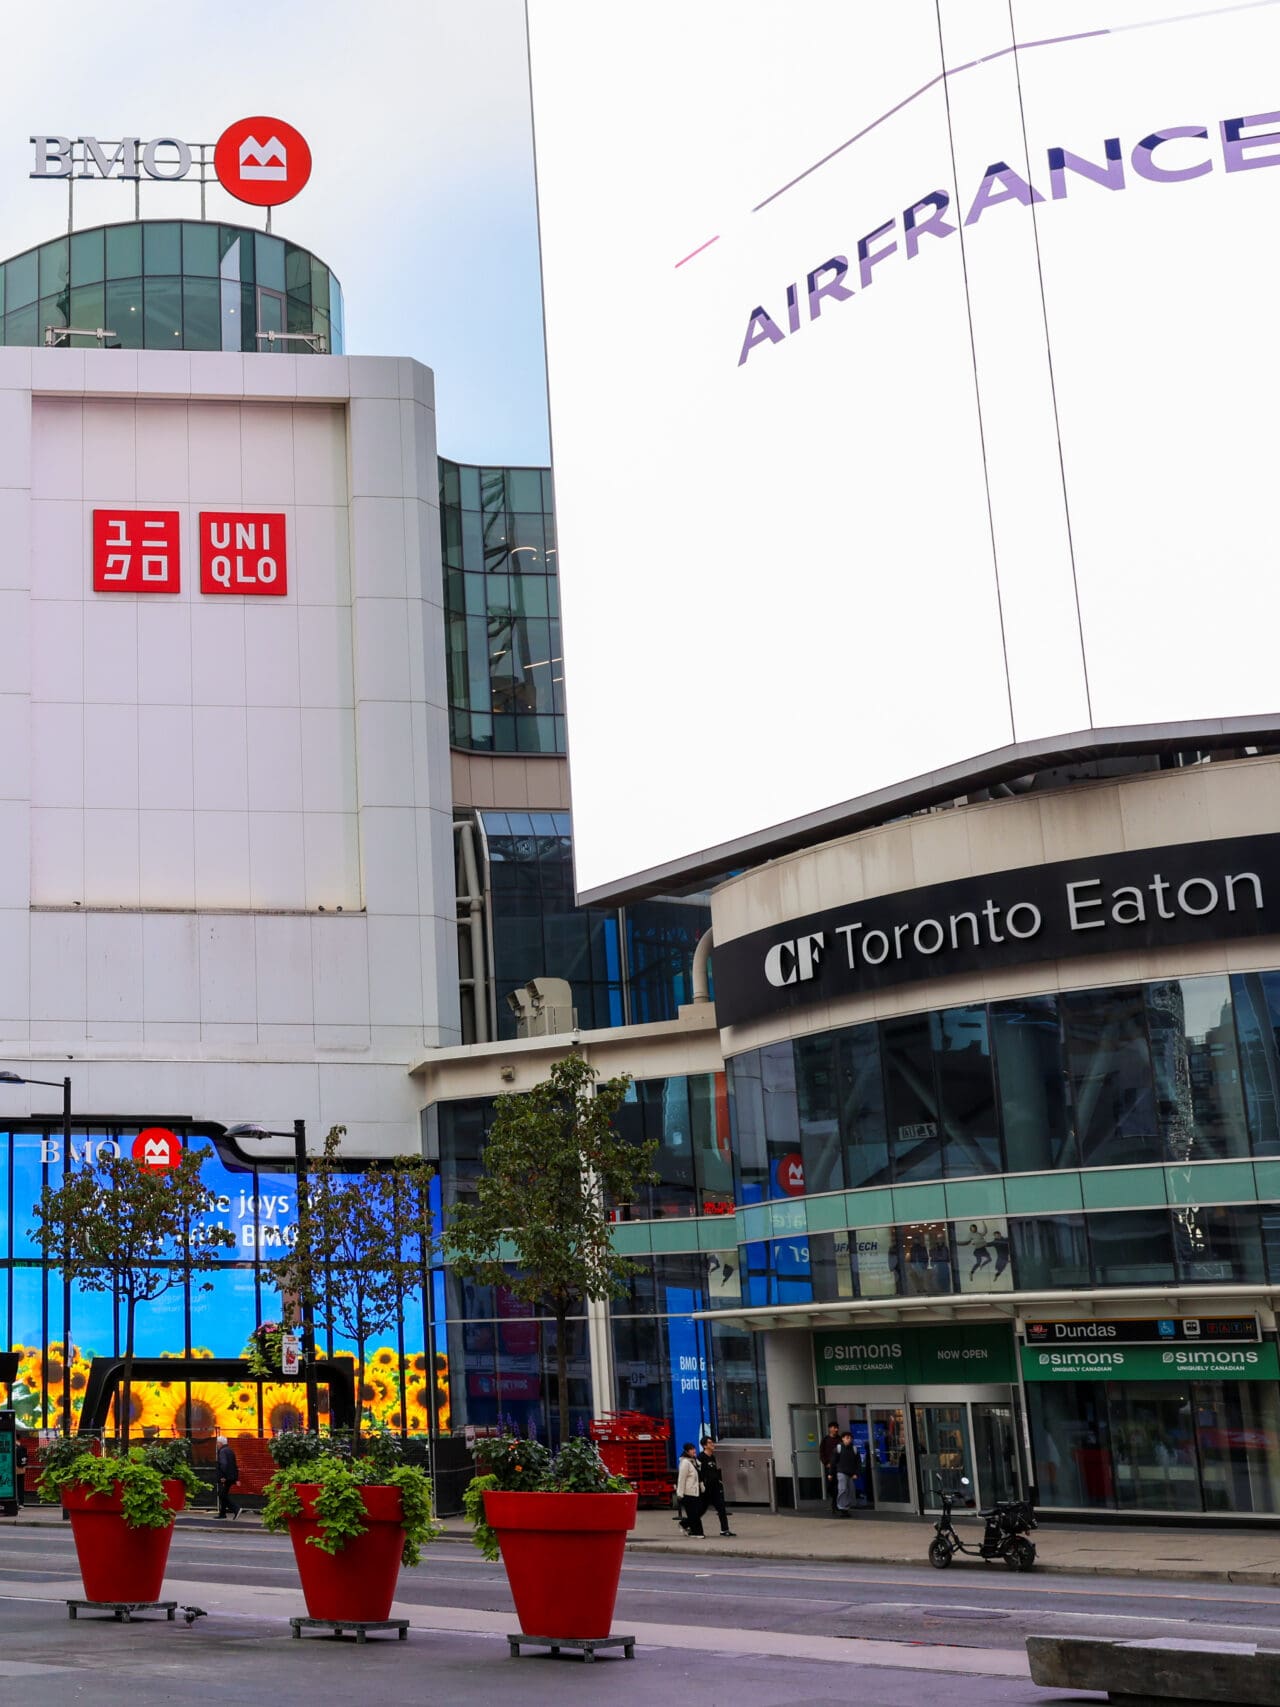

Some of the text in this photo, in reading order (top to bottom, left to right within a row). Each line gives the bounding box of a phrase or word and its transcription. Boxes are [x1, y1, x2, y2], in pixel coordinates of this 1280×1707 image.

[29, 135, 192, 181] BMO
[210, 522, 271, 550] UNI
[211, 555, 277, 587] QLO
[764, 871, 1265, 987] CF Toronto Eaton
[238, 1189, 290, 1219] joys
[1055, 1324, 1116, 1338] Dundas
[835, 1344, 902, 1359] simons
[937, 1350, 988, 1360] NOW OPEN
[1052, 1353, 1124, 1364] simons
[1173, 1352, 1258, 1363] simons
[680, 1356, 697, 1370] BMO
[863, 1363, 893, 1371] CANADIAN
